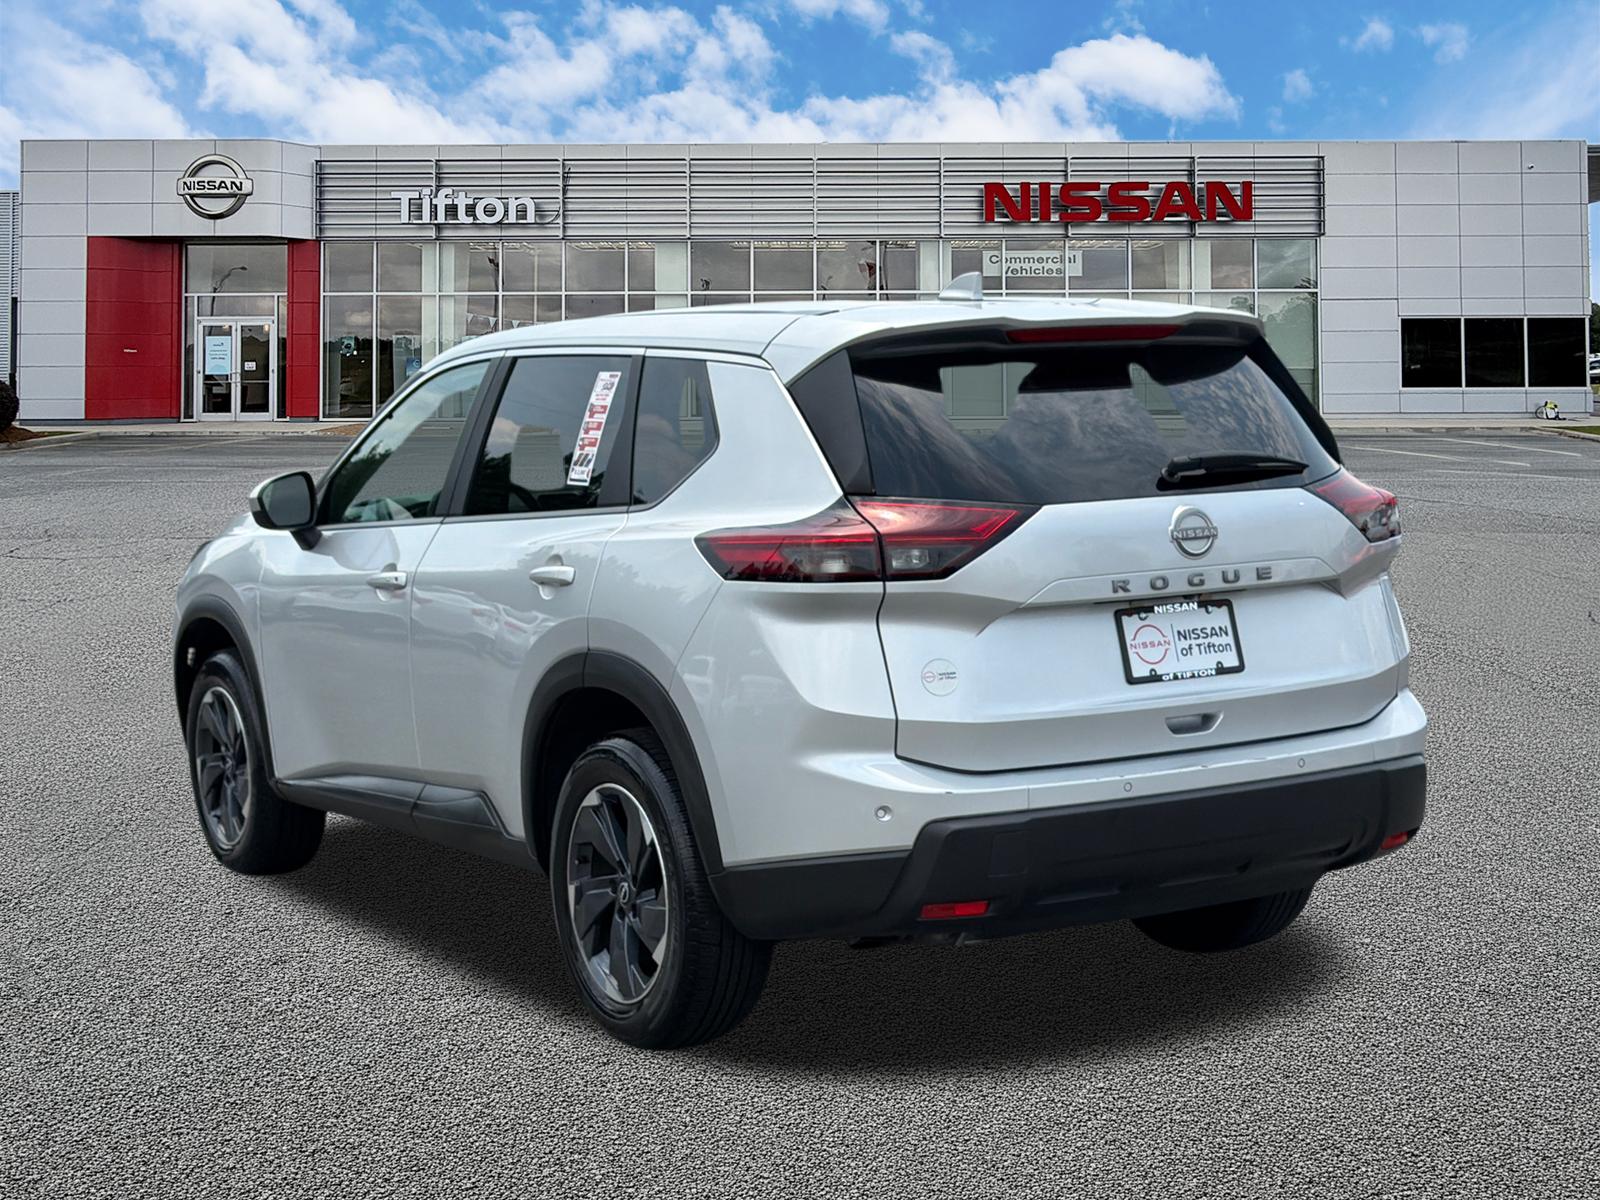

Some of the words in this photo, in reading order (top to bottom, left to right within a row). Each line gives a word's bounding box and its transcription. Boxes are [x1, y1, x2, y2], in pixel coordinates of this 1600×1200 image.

[182, 180, 243, 191] NISSAN
[391, 187, 536, 225] Tifton
[983, 180, 1254, 223] NISSAN
[1173, 528, 1217, 539] NISSAN
[1111, 566, 1273, 594] ROGUE
[1153, 602, 1199, 615] NISSAN
[1176, 625, 1229, 642] NISSAN
[1129, 639, 1171, 651] NISSAN
[1180, 643, 1194, 657] of
[1195, 641, 1233, 656] Tifton
[1161, 672, 1175, 681] of
[1175, 668, 1216, 680] TIFTON
